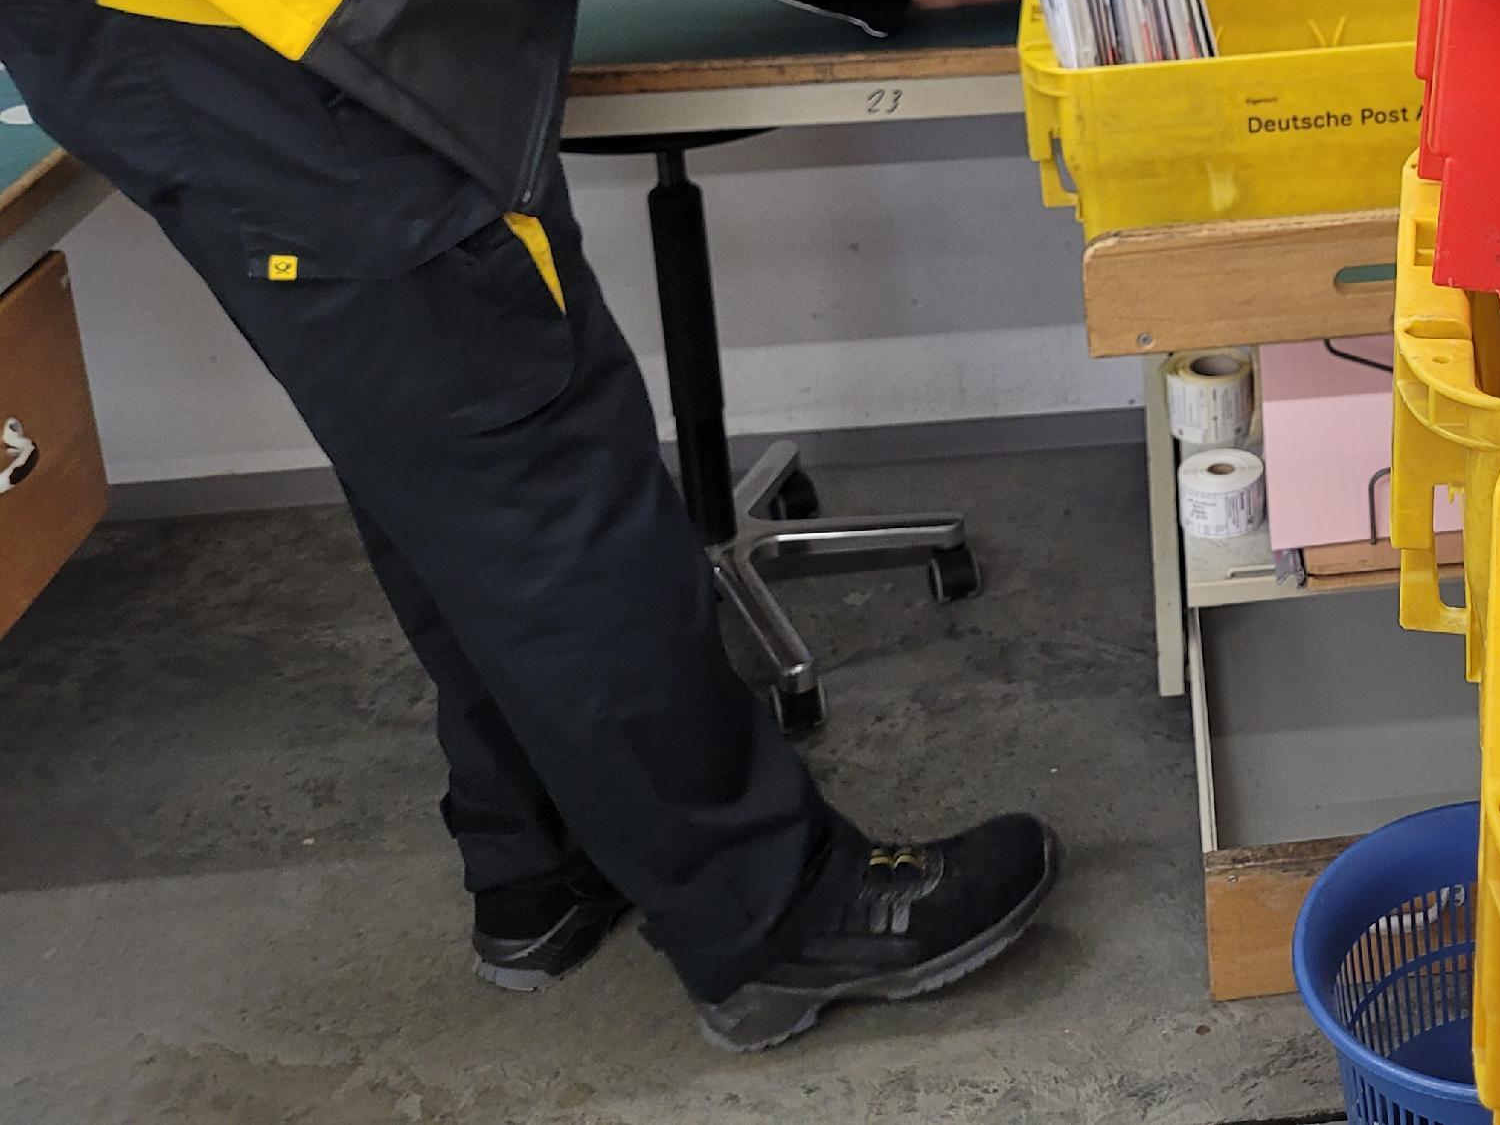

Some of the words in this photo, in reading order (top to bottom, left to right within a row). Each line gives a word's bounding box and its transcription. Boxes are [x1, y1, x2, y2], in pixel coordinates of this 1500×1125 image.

[866, 88, 903, 114] 23
[1247, 111, 1353, 134] Deutsche
[1360, 105, 1409, 126] Post
